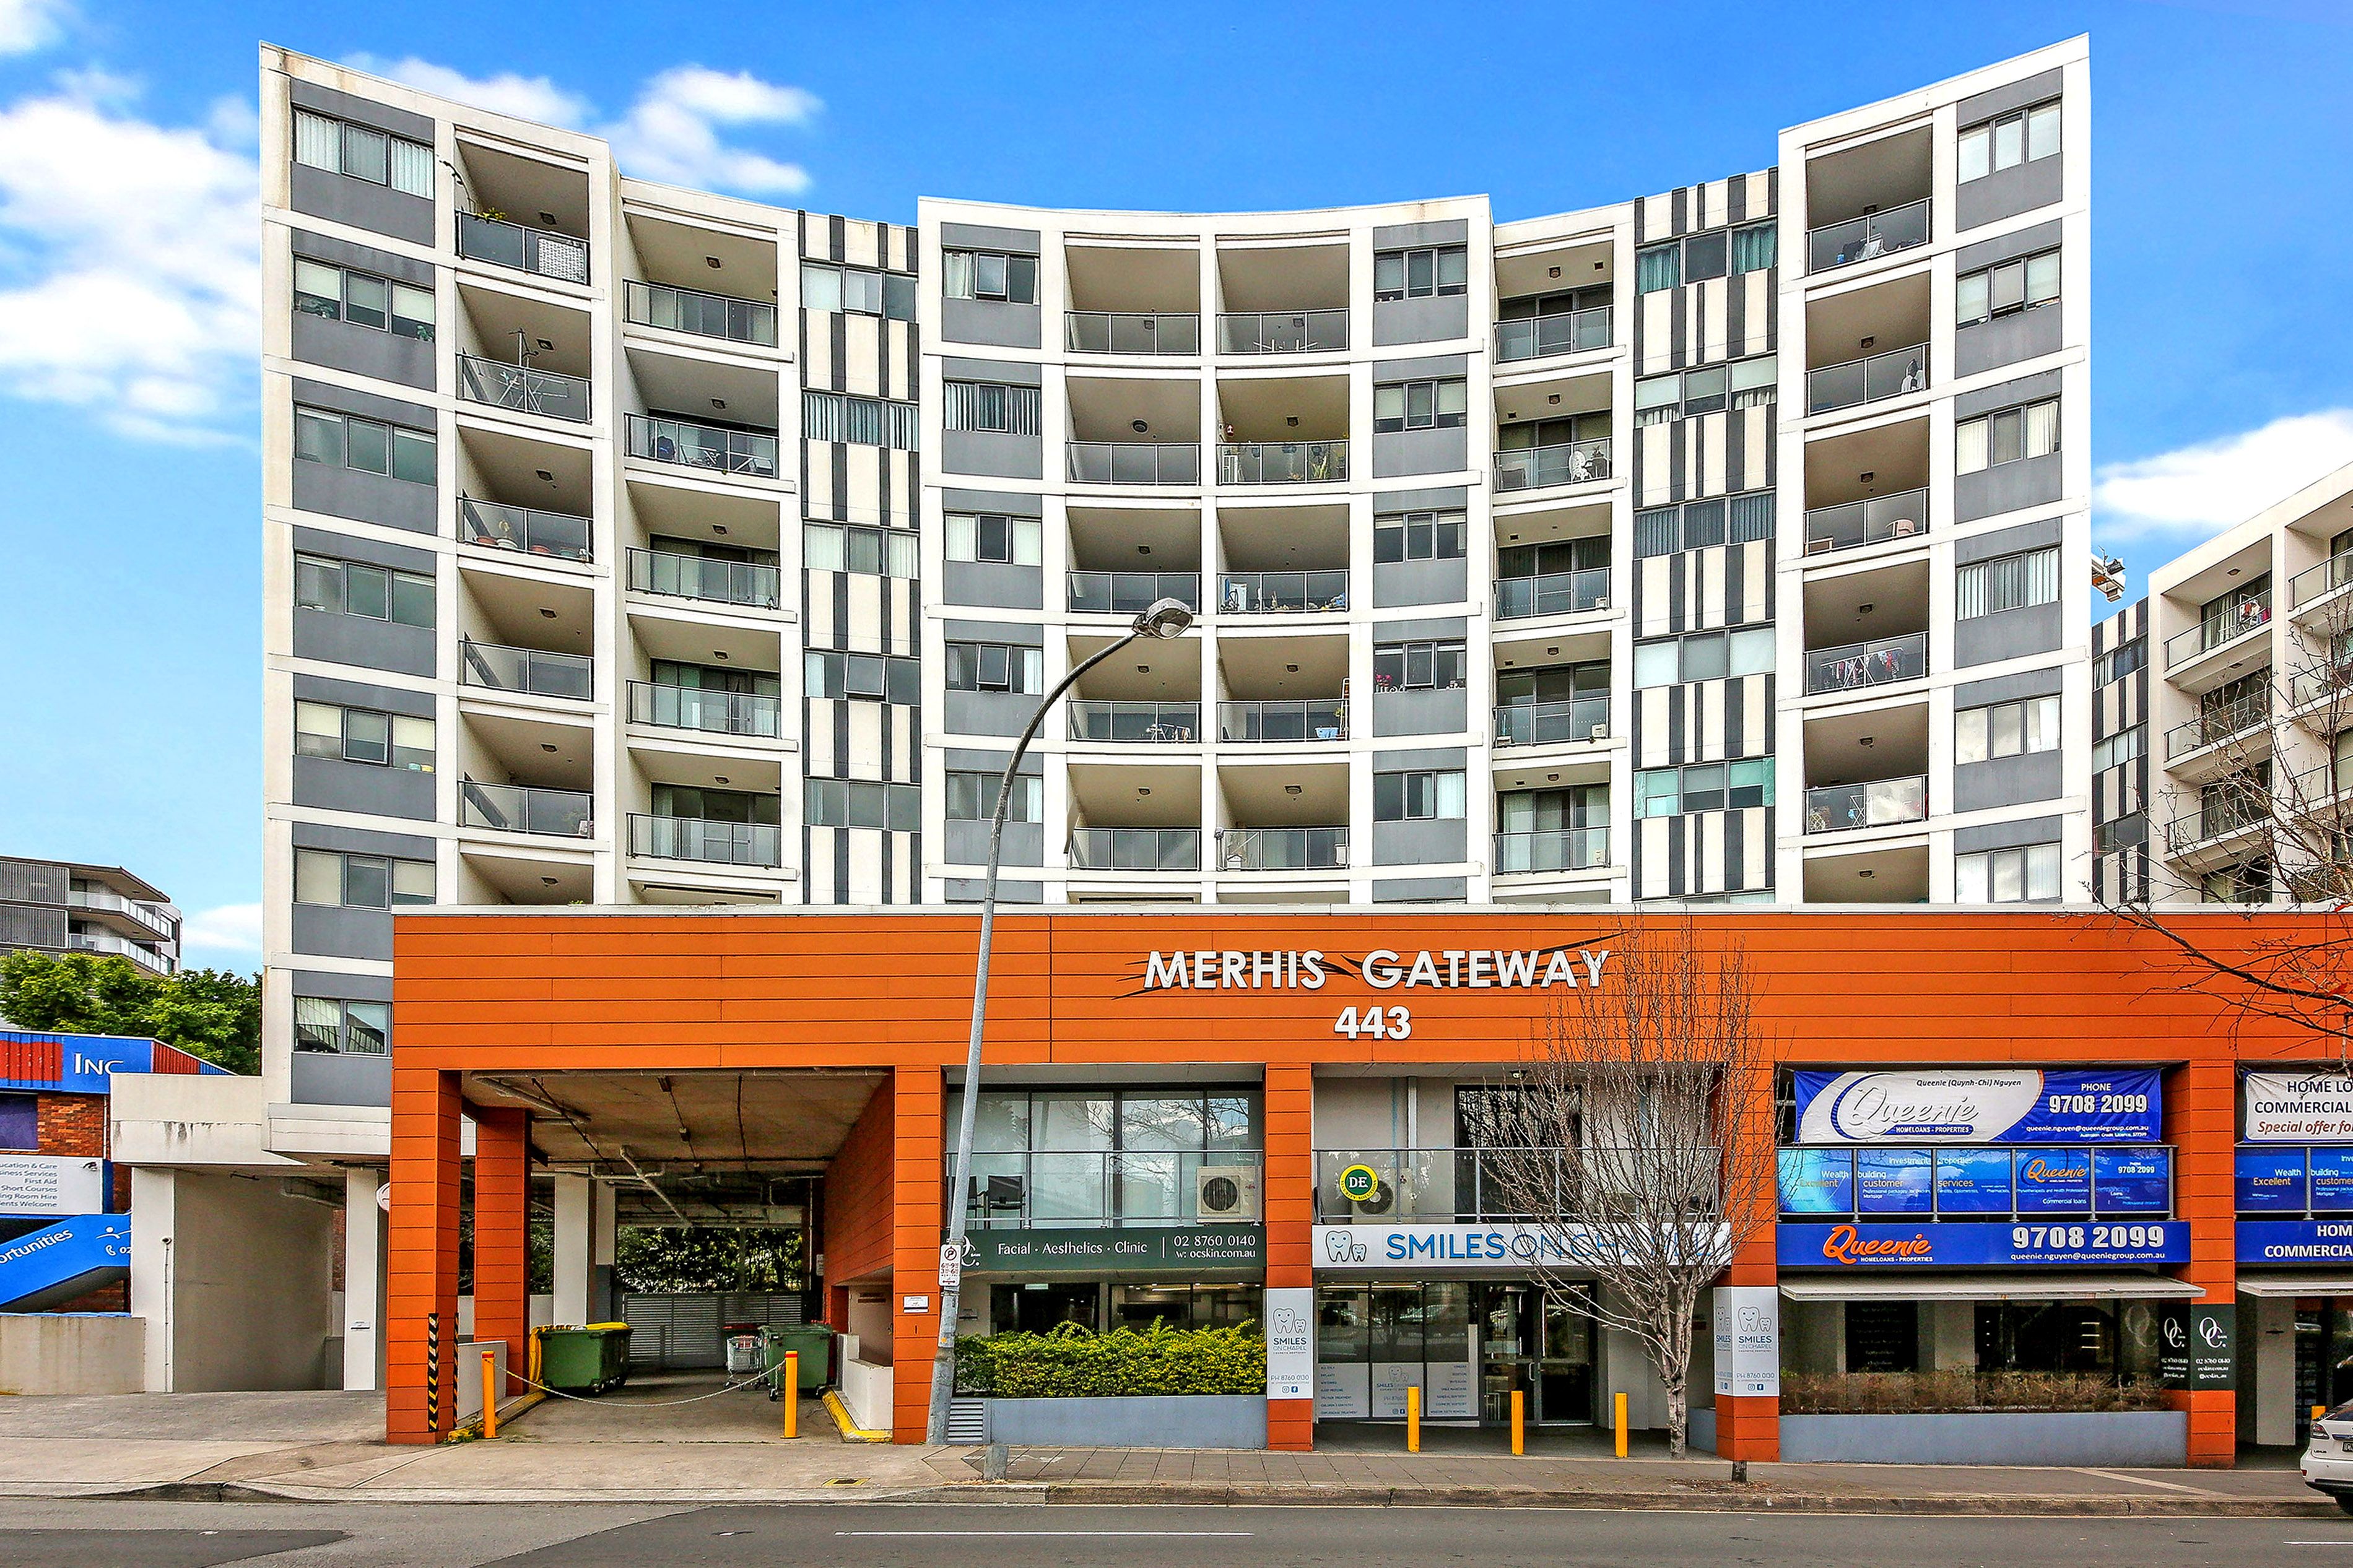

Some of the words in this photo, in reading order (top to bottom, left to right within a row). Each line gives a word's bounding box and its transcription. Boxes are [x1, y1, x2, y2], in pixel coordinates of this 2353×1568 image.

[1143, 950, 1328, 989] MERHIS
[1362, 950, 1611, 989] GATEWAY
[1334, 1006, 1411, 1040] 443
[1994, 1080, 2021, 1088] Nguyen
[2287, 1081, 2331, 1093] HOME
[2049, 1095, 2095, 1113] 9708
[2101, 1094, 2147, 1113] 2099
[2255, 1102, 2352, 1113] COMMERCIAL
[1848, 1087, 1980, 1135] Queenie
[2258, 1120, 2302, 1135] Special
[2305, 1120, 2336, 1135] offer
[1858, 1171, 1886, 1179] building
[2027, 1159, 2087, 1183] Queenie
[2311, 1168, 2339, 1177] building
[1349, 1177, 1368, 1188] DE
[1863, 1179, 1903, 1187] customer
[2253, 1177, 2291, 1185] Excellent
[1173, 1236, 1190, 1246] 02
[1194, 1235, 1223, 1246] 8760
[1228, 1235, 1256, 1246] 0140
[2012, 1226, 2084, 1248] 9708
[2092, 1226, 2164, 1248] 2099
[998, 1242, 1030, 1255] Facial
[1042, 1241, 1103, 1254] Aesthetics
[1115, 1241, 1147, 1253] Clinic
[1386, 1233, 1505, 1258] SMILES
[1823, 1225, 1932, 1264] Queenie
[1190, 1248, 1256, 1258] ocskin.com.au
[2011, 1252, 2165, 1260] queenie.nguyen@queeniegroup.com.au
[1273, 1337, 1307, 1345] SMILES
[1716, 1335, 1731, 1343] SMILES
